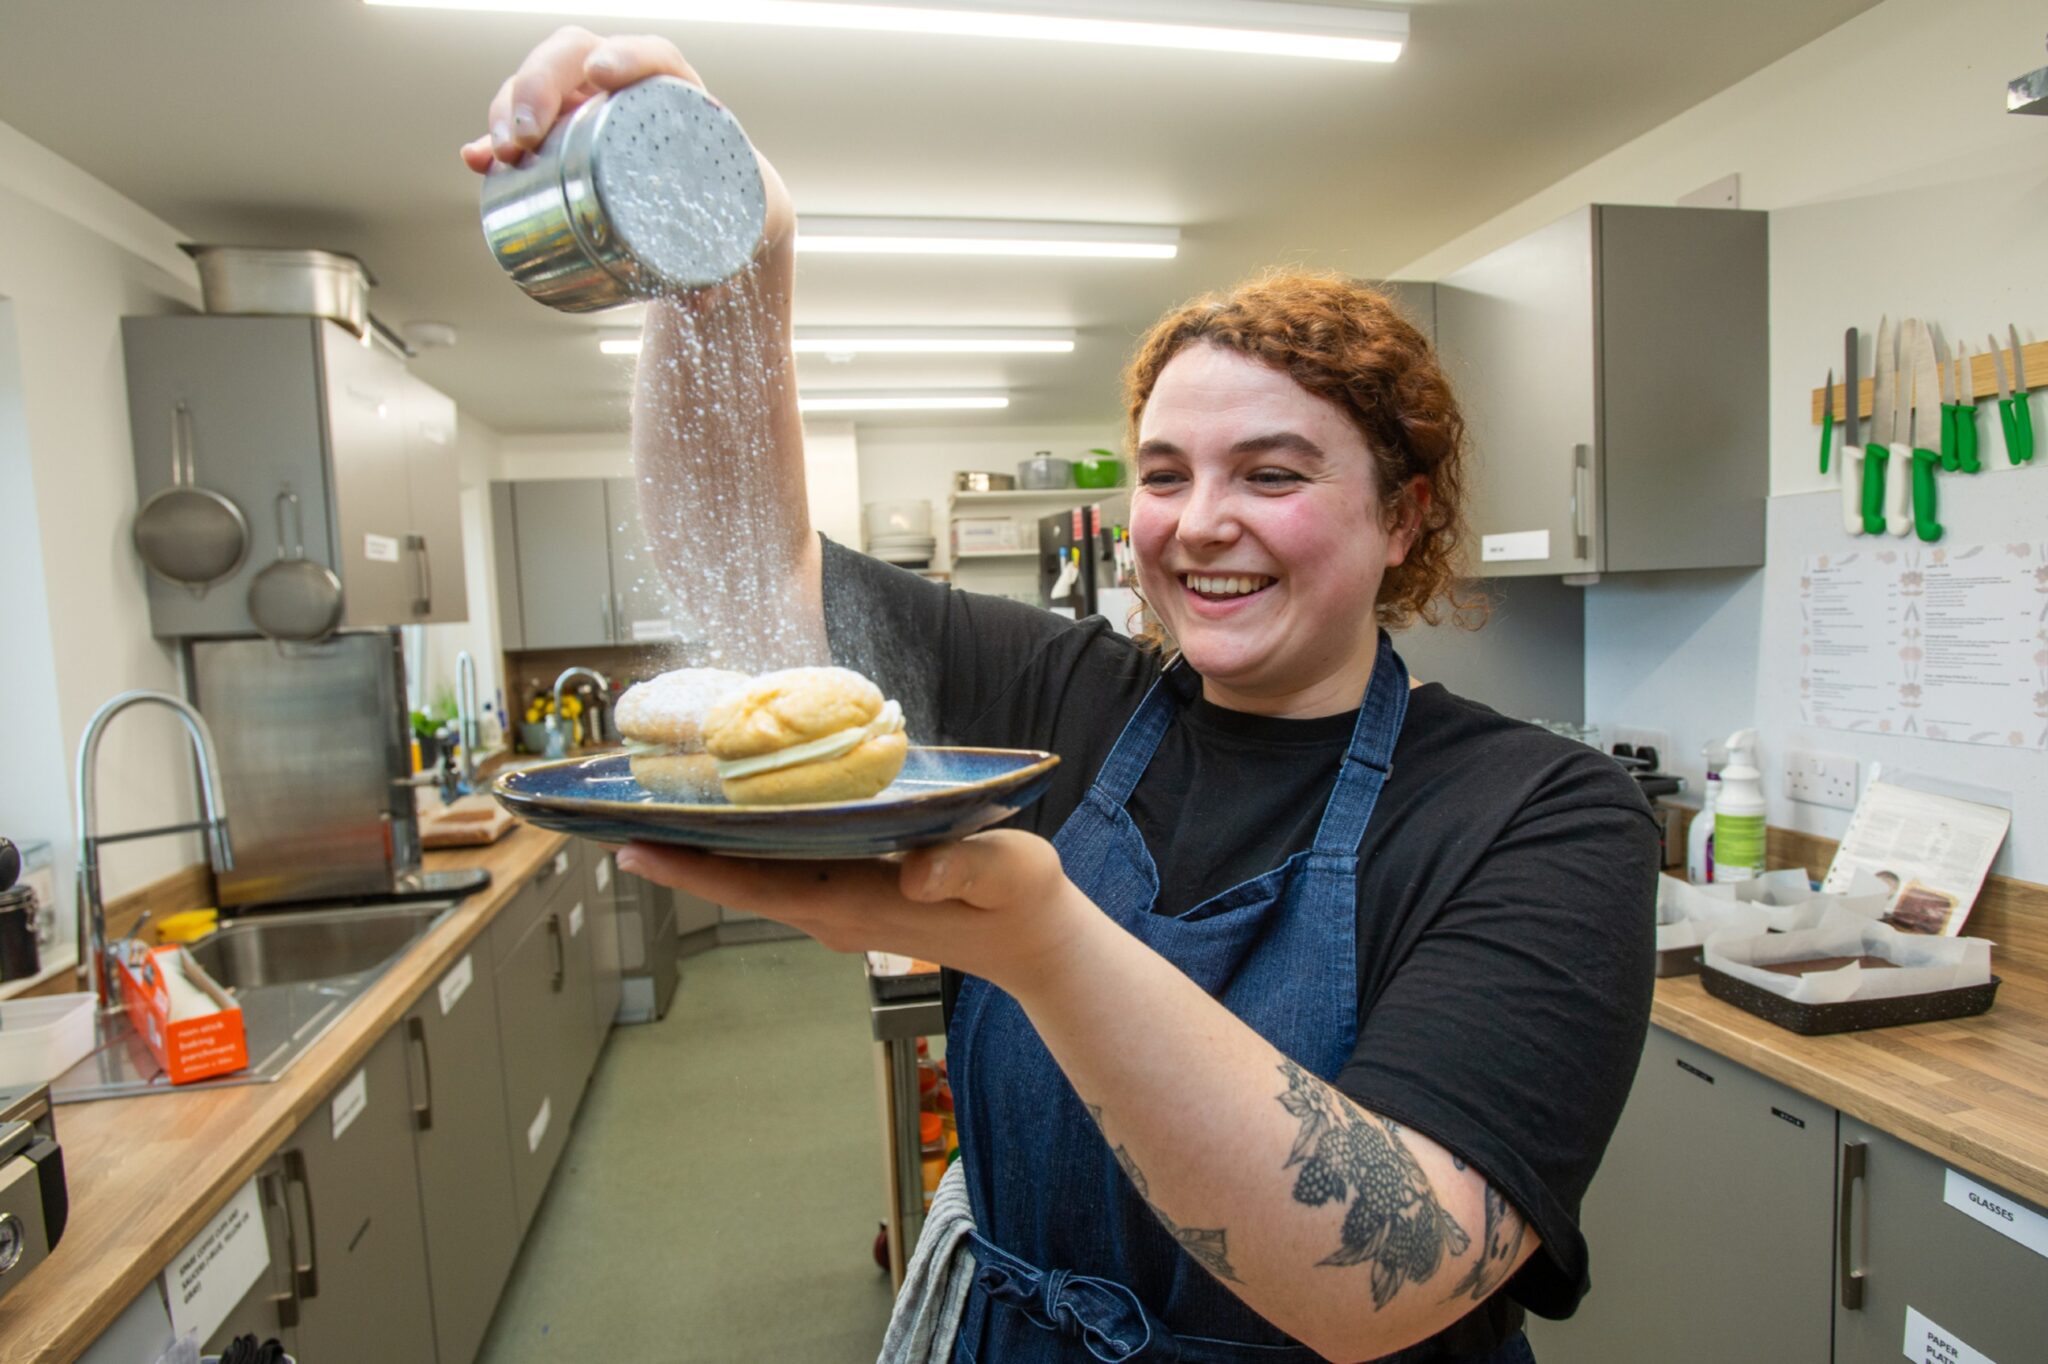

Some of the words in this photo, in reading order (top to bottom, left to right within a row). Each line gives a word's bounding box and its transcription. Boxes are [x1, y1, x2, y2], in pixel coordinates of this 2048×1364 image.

[179, 1036, 215, 1052] baking
[1968, 1192, 2015, 1222] GLASSES
[1927, 1331, 1959, 1359] PAPER
